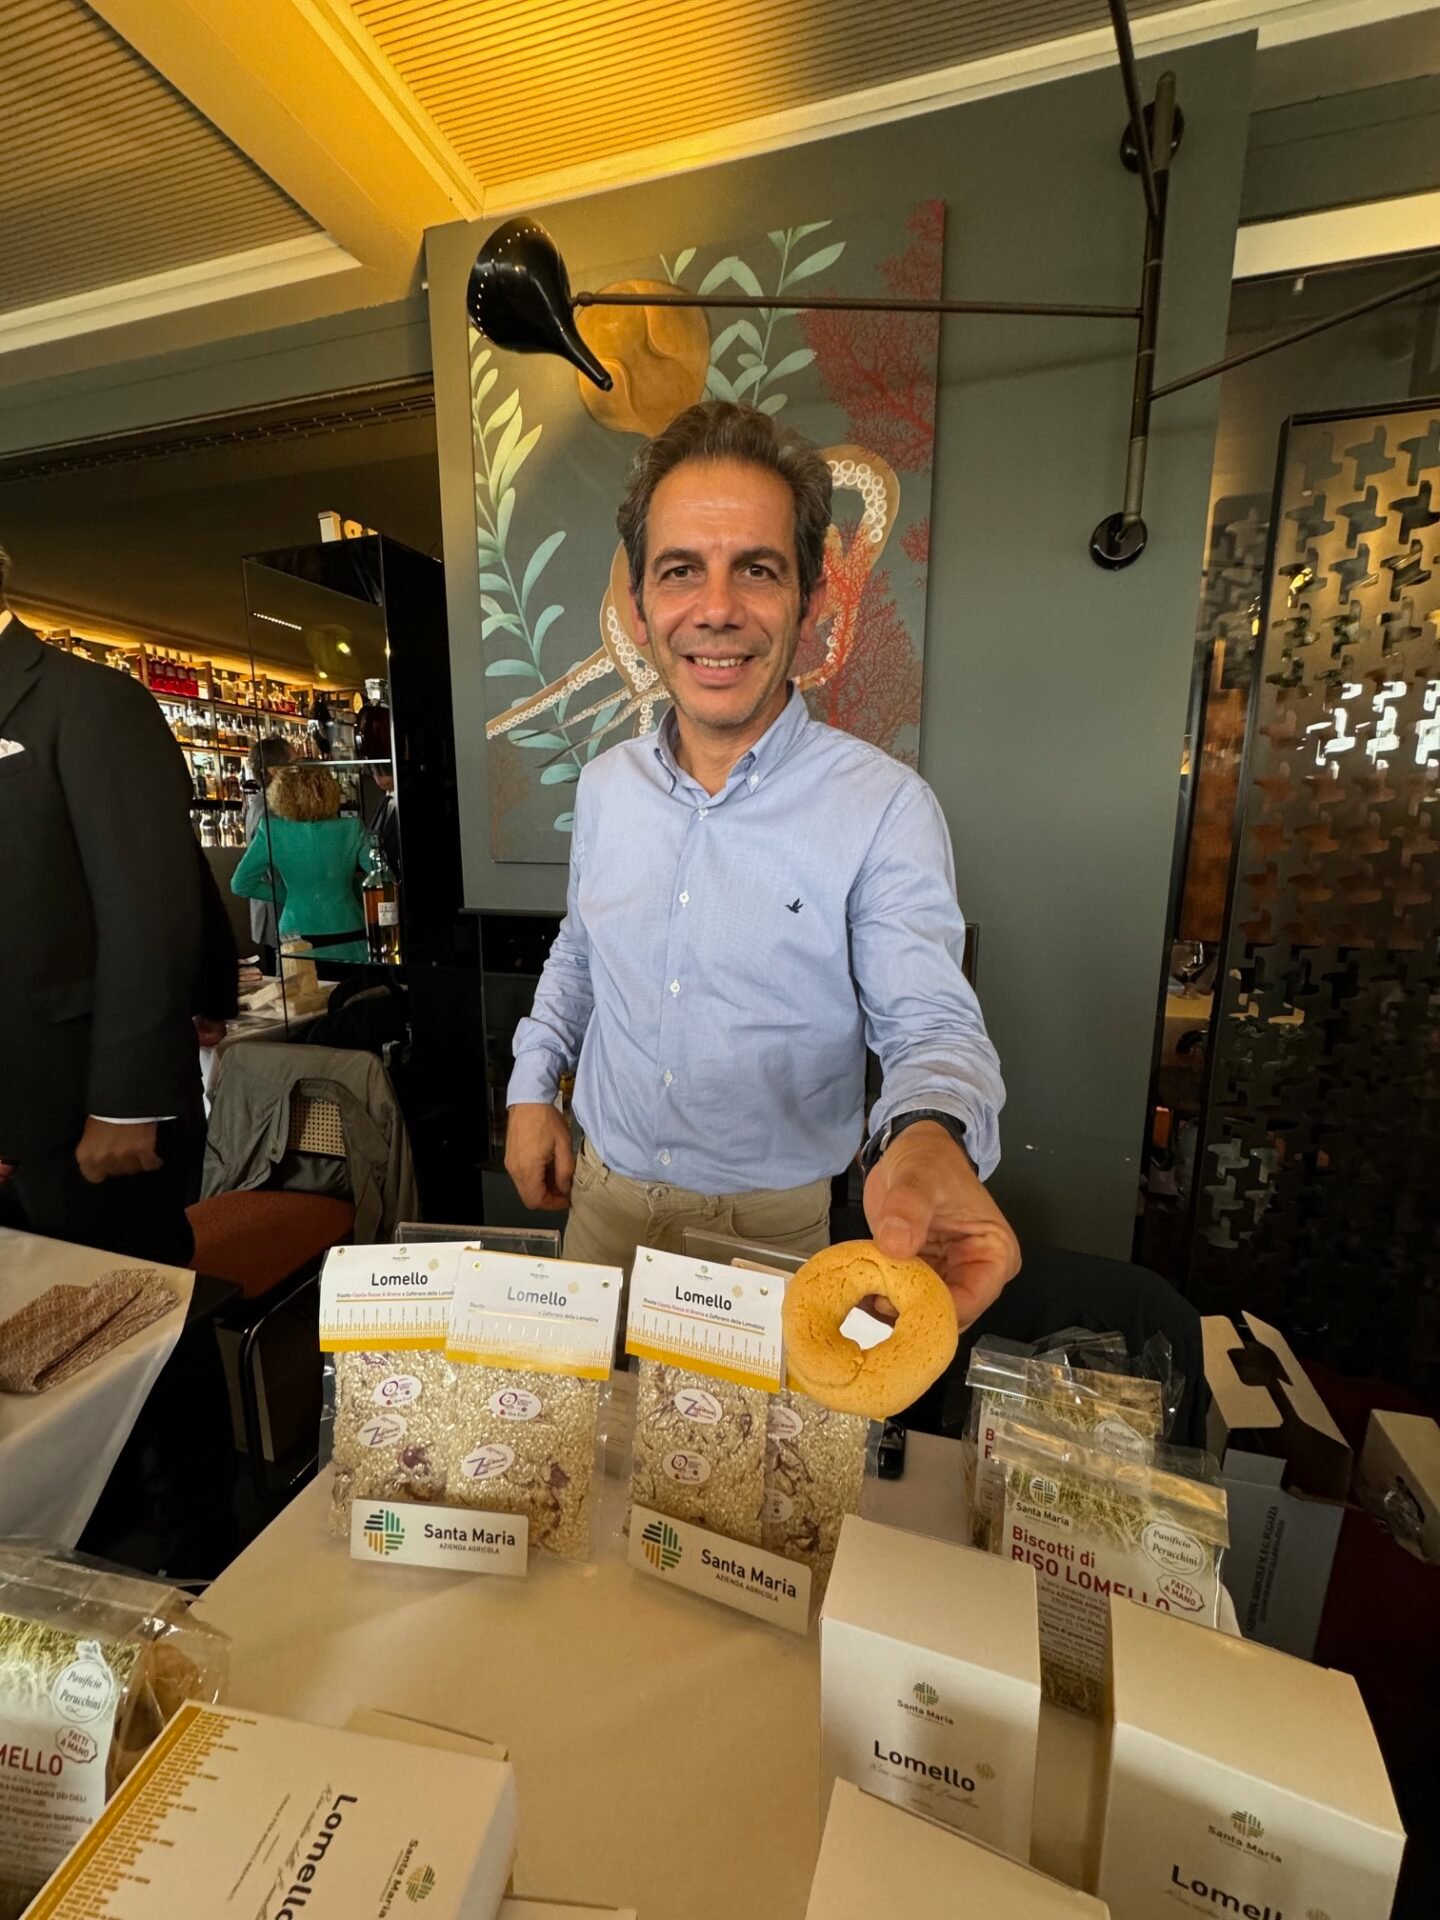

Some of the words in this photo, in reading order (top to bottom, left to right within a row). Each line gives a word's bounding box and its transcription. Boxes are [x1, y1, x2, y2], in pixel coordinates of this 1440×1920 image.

[371, 1272, 428, 1286] Lomello
[507, 1286, 567, 1306] Lomello
[675, 1286, 732, 1311] Lomello
[1016, 1502, 1042, 1518] Santa
[1044, 1508, 1070, 1526] Maria
[424, 1524, 468, 1542] Santa
[472, 1528, 516, 1546] Maria
[1012, 1526, 1074, 1562] Biscotti
[1080, 1550, 1096, 1568] di
[1153, 1529, 1192, 1549] Panificio
[439, 1543, 466, 1552] AZIENDA
[468, 1545, 500, 1554] AGRICOLA
[1012, 1544, 1059, 1577] RISO
[1152, 1542, 1199, 1568] Perucchini
[700, 1548, 746, 1579] Santa
[750, 1567, 797, 1598] Maria
[716, 1573, 744, 1590] AZIENDA
[746, 1585, 779, 1602] AGRICOLA
[1164, 1584, 1171, 1593] A
[1170, 1588, 1196, 1607] MANO
[1170, 1578, 1193, 1596] FATTI
[67, 1670, 102, 1690] Panificio
[59, 1688, 102, 1711] Perucchini
[898, 1699, 924, 1715] Santa
[926, 1708, 954, 1726] Maria
[60, 1738, 66, 1747] A
[67, 1742, 90, 1758] MANO
[68, 1730, 89, 1746] FATTI
[874, 1740, 975, 1792] Lomello
[1208, 1824, 1242, 1847] Santa
[1246, 1841, 1282, 1864] Maria
[275, 1794, 358, 1920] Lomello
[396, 1838, 418, 1876] Santa
[378, 1878, 402, 1919] Maria
